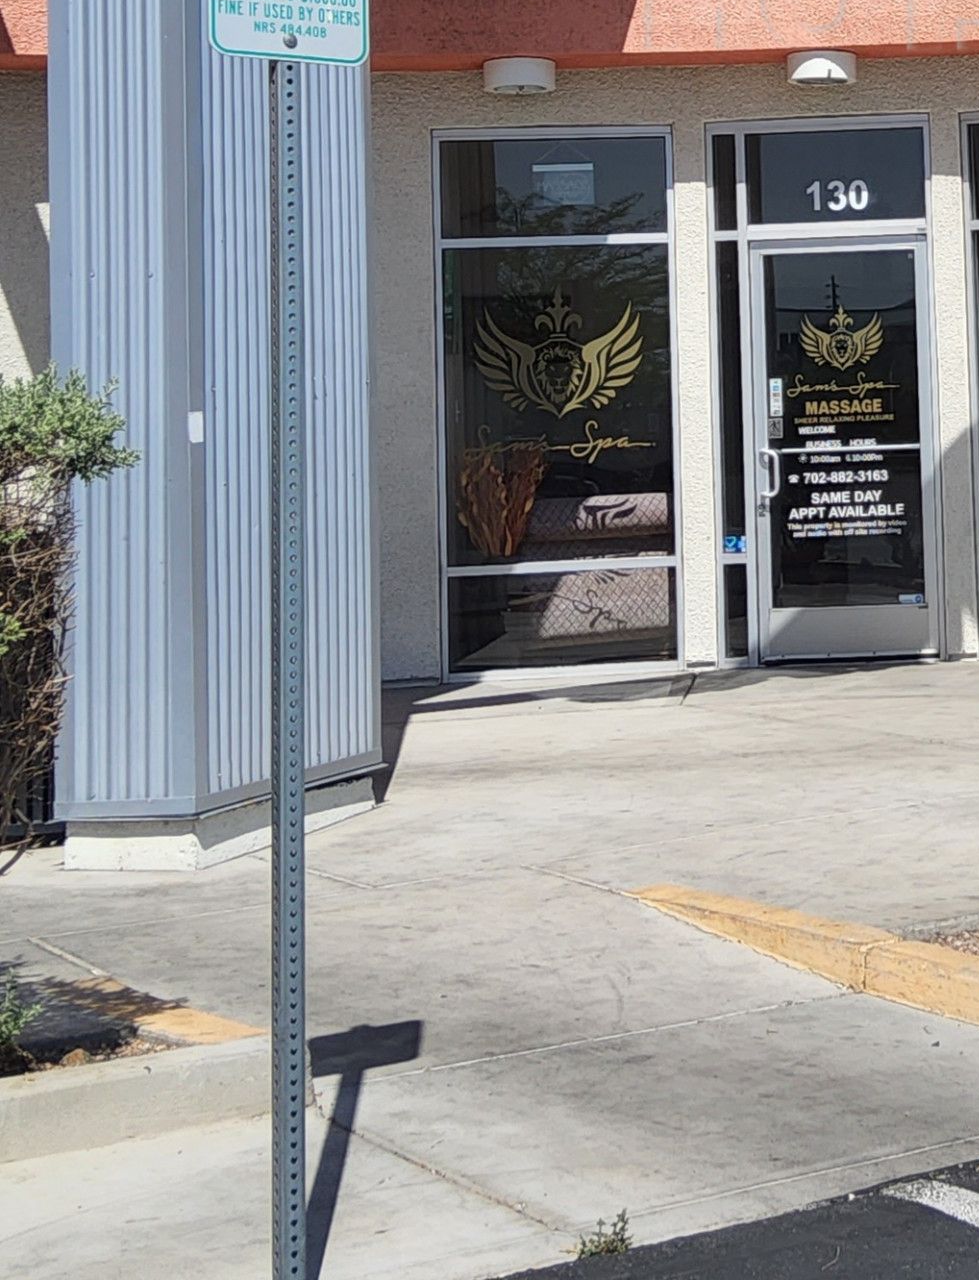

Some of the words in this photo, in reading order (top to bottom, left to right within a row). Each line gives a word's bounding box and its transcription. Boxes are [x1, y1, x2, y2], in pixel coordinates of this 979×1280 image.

[218, 0, 244, 16] FINE
[249, 2, 258, 17] IF
[264, 2, 293, 20] USED
[299, 6, 313, 22] BY
[254, 21, 276, 33] NRS
[280, 23, 327, 38] 484.408
[806, 180, 869, 211] 130
[787, 374, 849, 398] Sam's
[849, 371, 900, 398] Spa
[805, 399, 882, 415] MASSAGE
[819, 415, 855, 423] RELAXING
[856, 413, 894, 421] PLEASURE
[797, 425, 836, 435] WELCOME
[569, 420, 656, 464] Spa
[805, 439, 842, 449] BUSINESS
[848, 438, 877, 447] HOURS
[803, 469, 889, 484] 702-882-3163
[811, 490, 851, 505] SAME
[854, 489, 882, 502] DAY
[789, 507, 826, 520] APPT
[828, 503, 905, 518] AVAILABLE
[787, 522, 803, 531] This
[888, 519, 907, 527] video
[868, 527, 902, 535] recording
